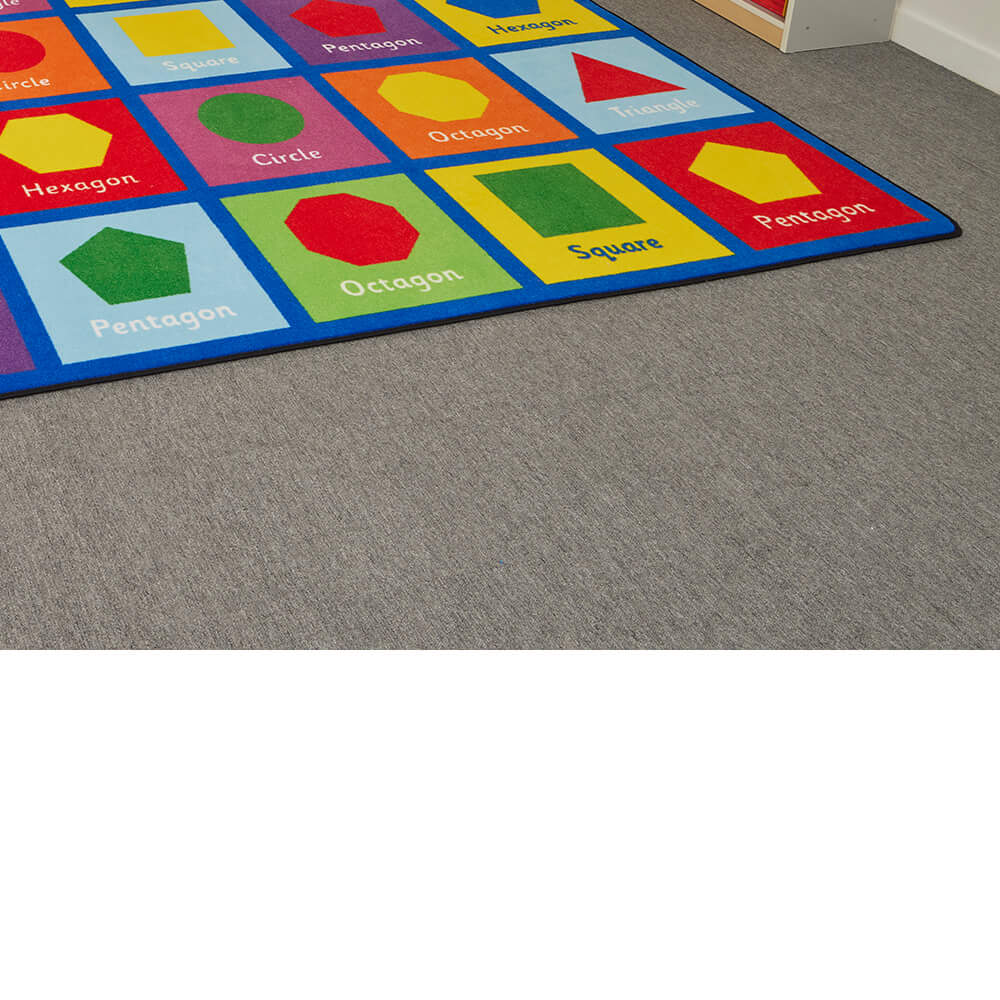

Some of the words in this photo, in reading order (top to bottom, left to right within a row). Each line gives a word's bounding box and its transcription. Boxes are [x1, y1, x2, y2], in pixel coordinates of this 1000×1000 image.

[486, 14, 579, 37] Hexagon
[321, 38, 423, 54] Pentagon
[160, 52, 241, 73] Square
[607, 97, 701, 119] Triangle
[427, 125, 529, 143] Octagon
[251, 148, 322, 166] Circle
[21, 175, 140, 198] Hexagon
[752, 203, 876, 230] Pentagon
[566, 233, 663, 263] Square
[339, 269, 465, 297] Octagon
[89, 305, 238, 338] Pentagon
